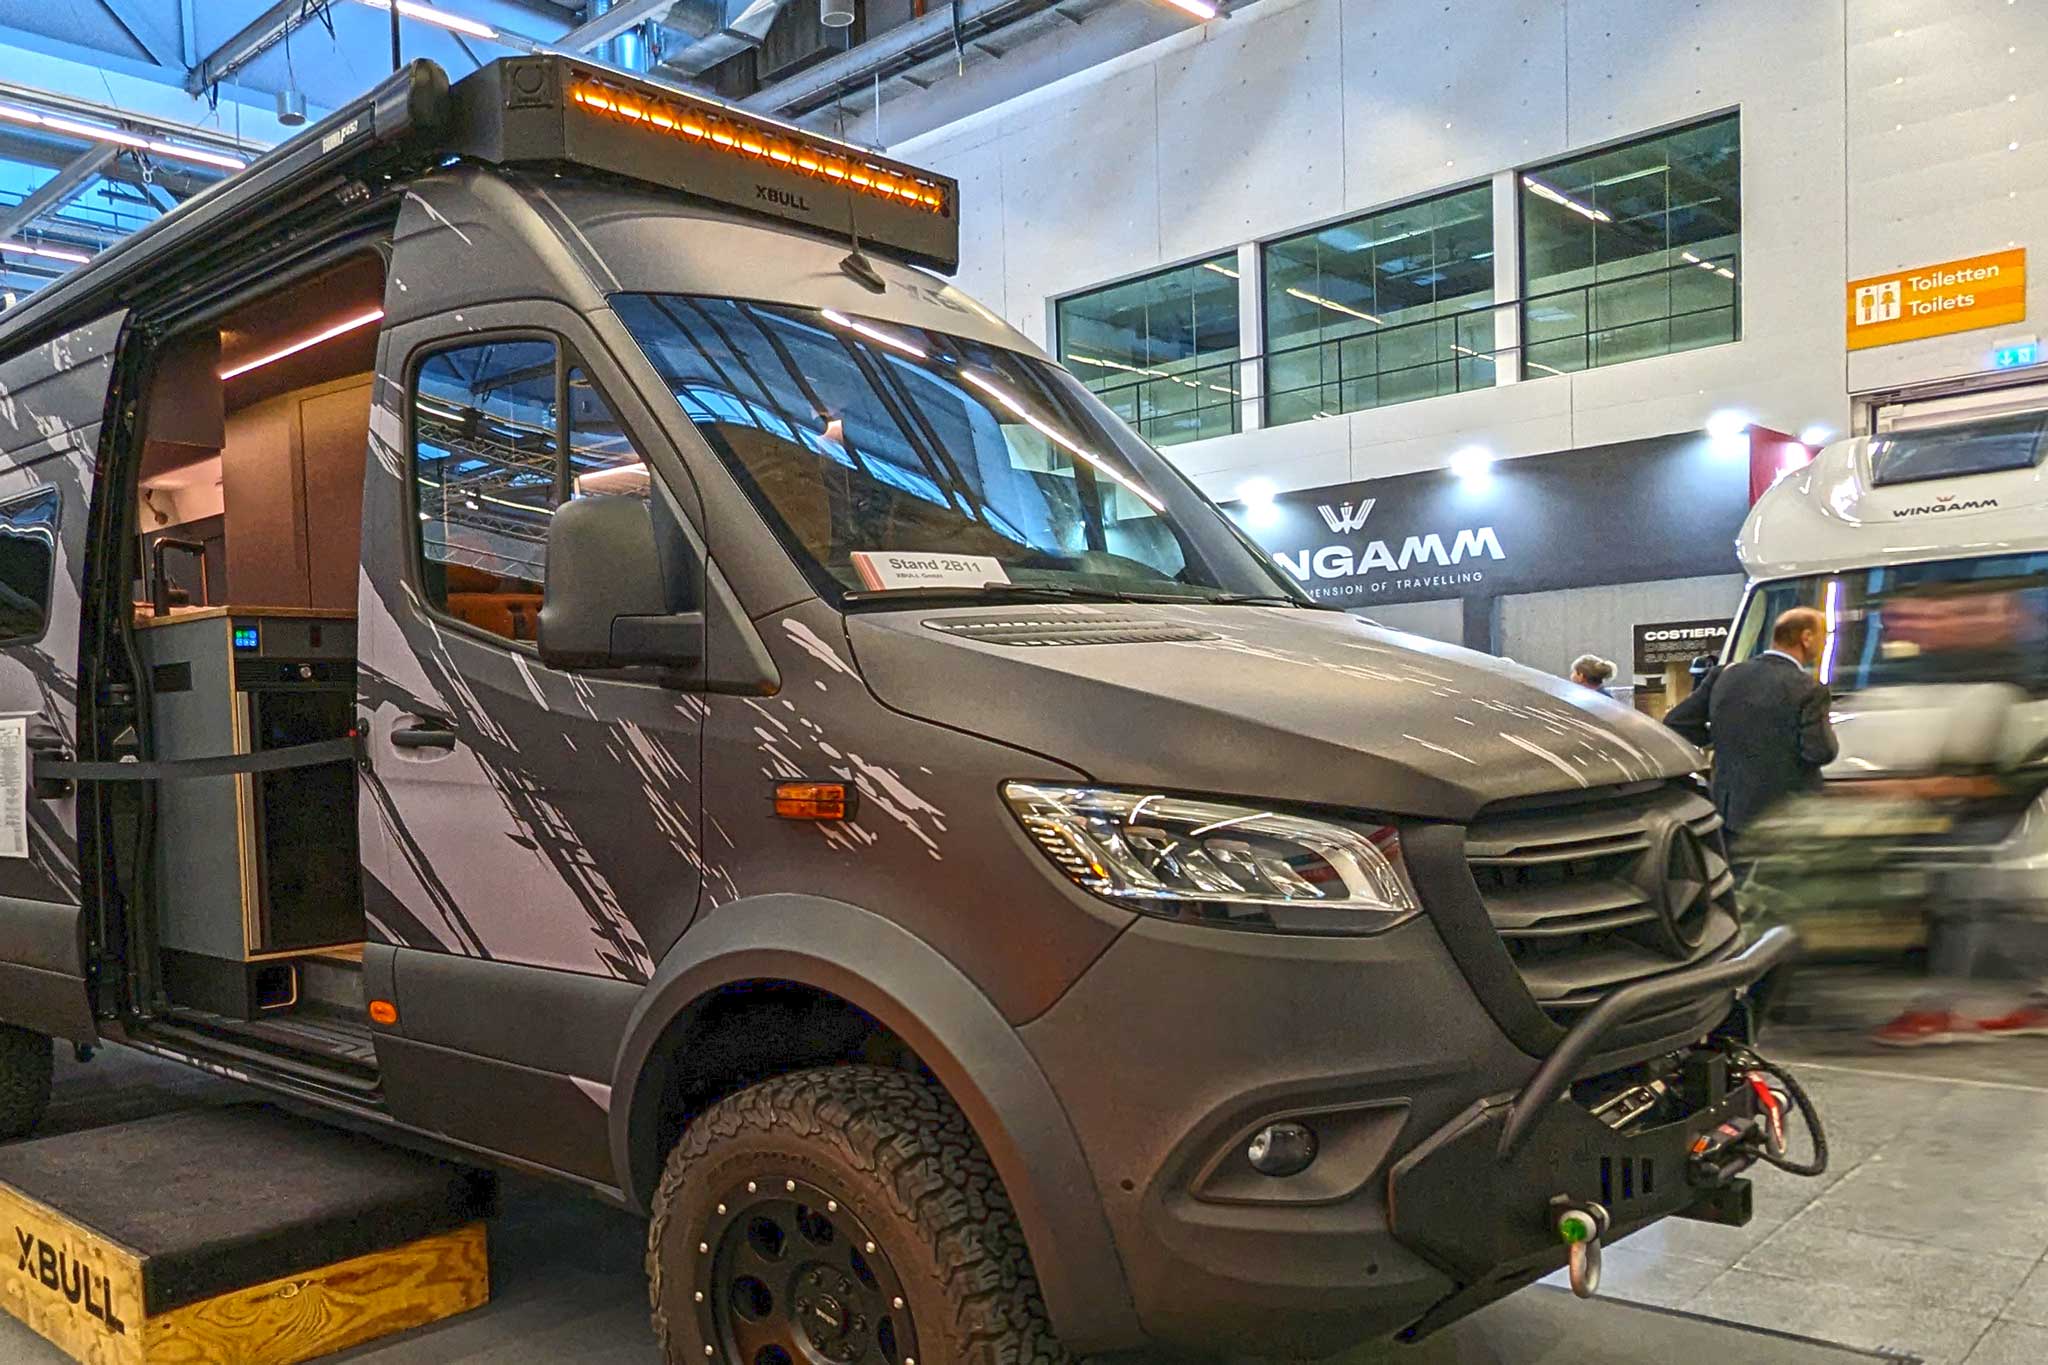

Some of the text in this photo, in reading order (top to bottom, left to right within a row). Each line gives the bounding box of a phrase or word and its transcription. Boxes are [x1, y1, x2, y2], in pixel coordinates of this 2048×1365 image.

[756, 184, 810, 211] XBULL
[1908, 265, 1999, 291] Toiletten
[1907, 294, 1975, 316] Toilets
[1893, 499, 1998, 517] WINGAMM
[889, 558, 982, 572] Stand 2B11
[1272, 527, 1506, 581] NGAMM
[1371, 582, 1388, 592] OF
[1396, 572, 1483, 590] TRAVELLING
[1644, 627, 1728, 641] COSTIERA
[15, 1226, 125, 1335] XBULL
